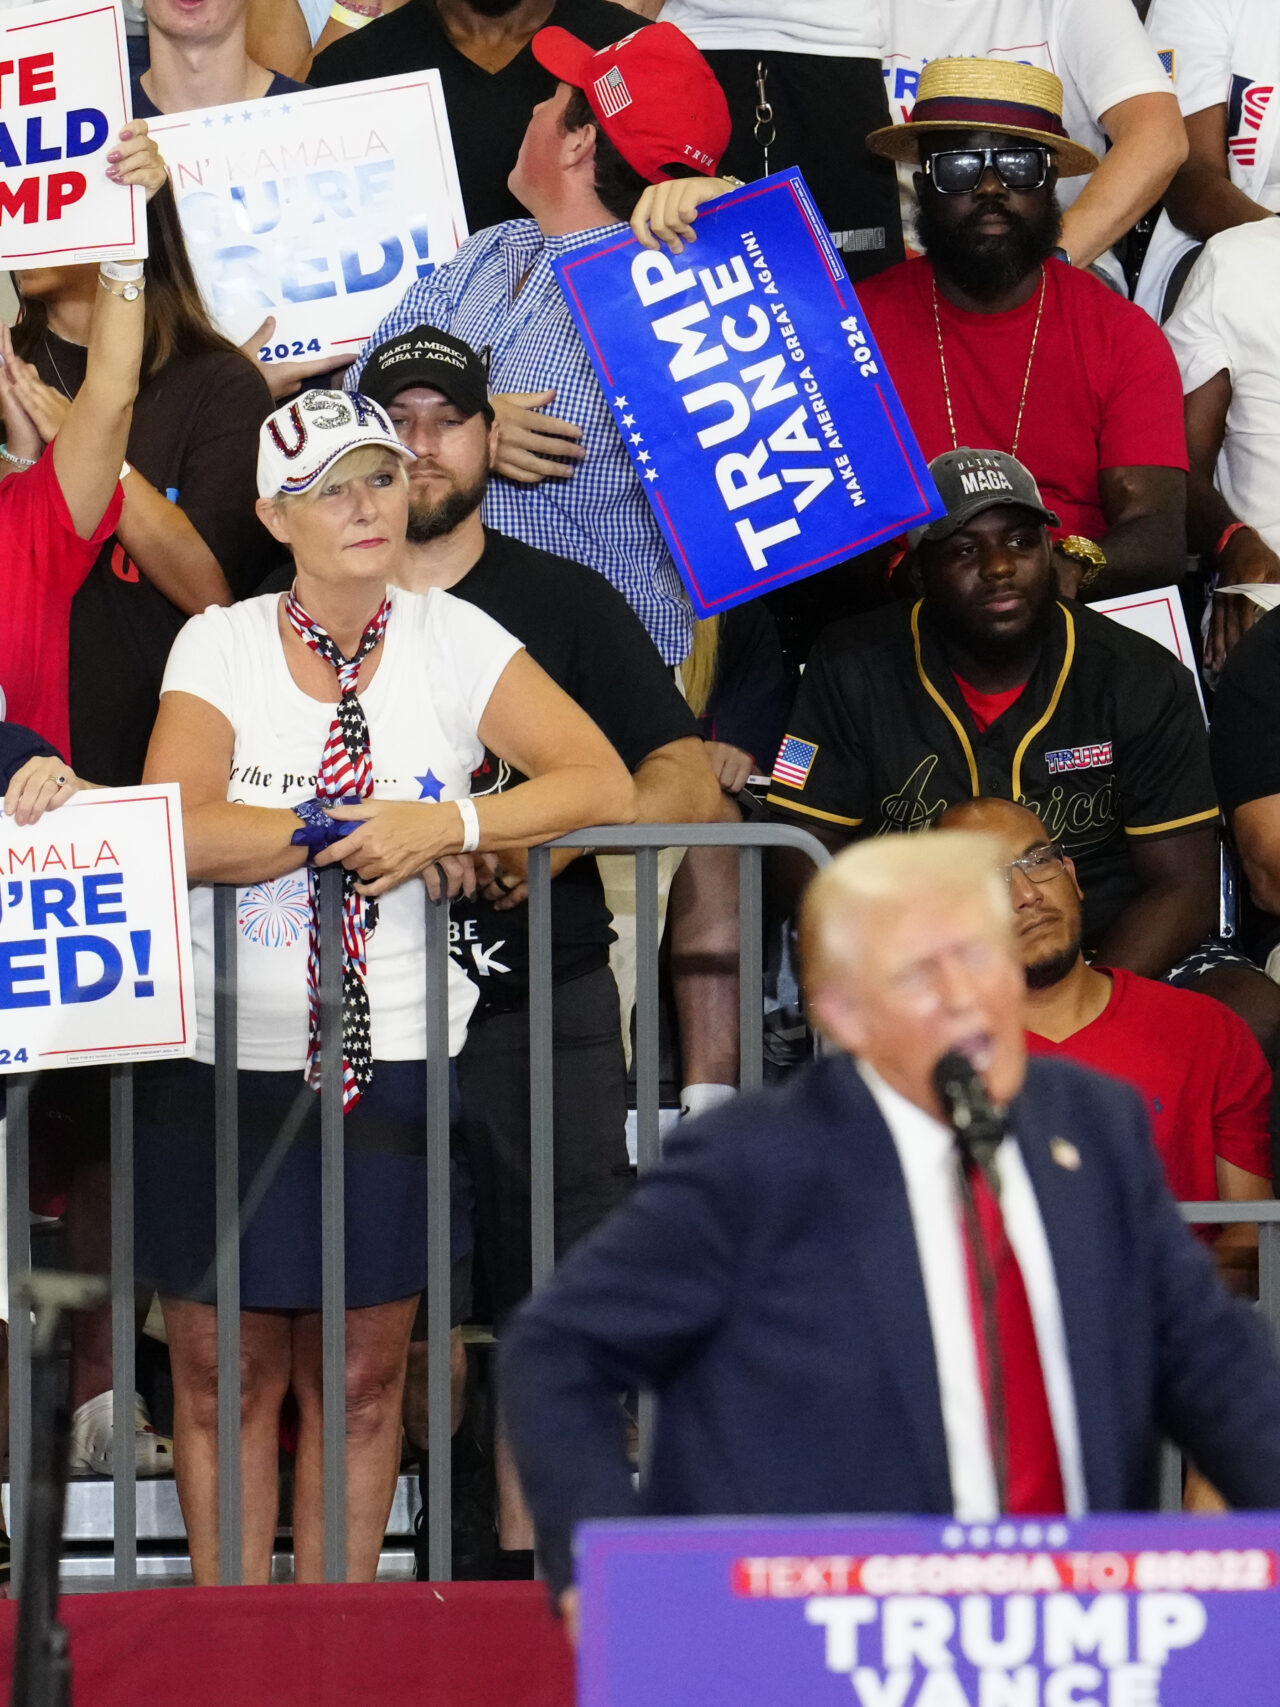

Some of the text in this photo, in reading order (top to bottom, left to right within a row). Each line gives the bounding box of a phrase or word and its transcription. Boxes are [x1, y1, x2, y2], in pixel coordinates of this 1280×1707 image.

[166, 156, 210, 189] IN'
[0, 170, 87, 227] MP
[177, 159, 396, 245] OU'RE
[211, 213, 436, 317] RED!
[260, 338, 322, 362] 2024
[378, 340, 468, 366] MAKE AMERICA
[381, 350, 465, 370] GREAT AGAIN
[741, 230, 866, 508] MAKE AMERICA GREAT AGAIN!
[841, 315, 879, 378] 2024
[700, 255, 834, 513] VANCE
[266, 388, 391, 460] USA
[631, 250, 801, 571] TRUMP
[958, 458, 1000, 470] ULTRA
[960, 470, 1013, 494] MAGA
[241, 766, 272, 788] the
[1045, 741, 1114, 774] TRUM
[0, 839, 120, 876] MALA
[0, 872, 127, 930] 'RE
[0, 929, 154, 1010] ED!
[743, 1556, 852, 1598] TEXT
[860, 1552, 1061, 1596] GEORGIA
[1067, 1552, 1130, 1592] TO
[804, 1594, 1208, 1675] TRUMP
[851, 1663, 1161, 1707] VANCE
